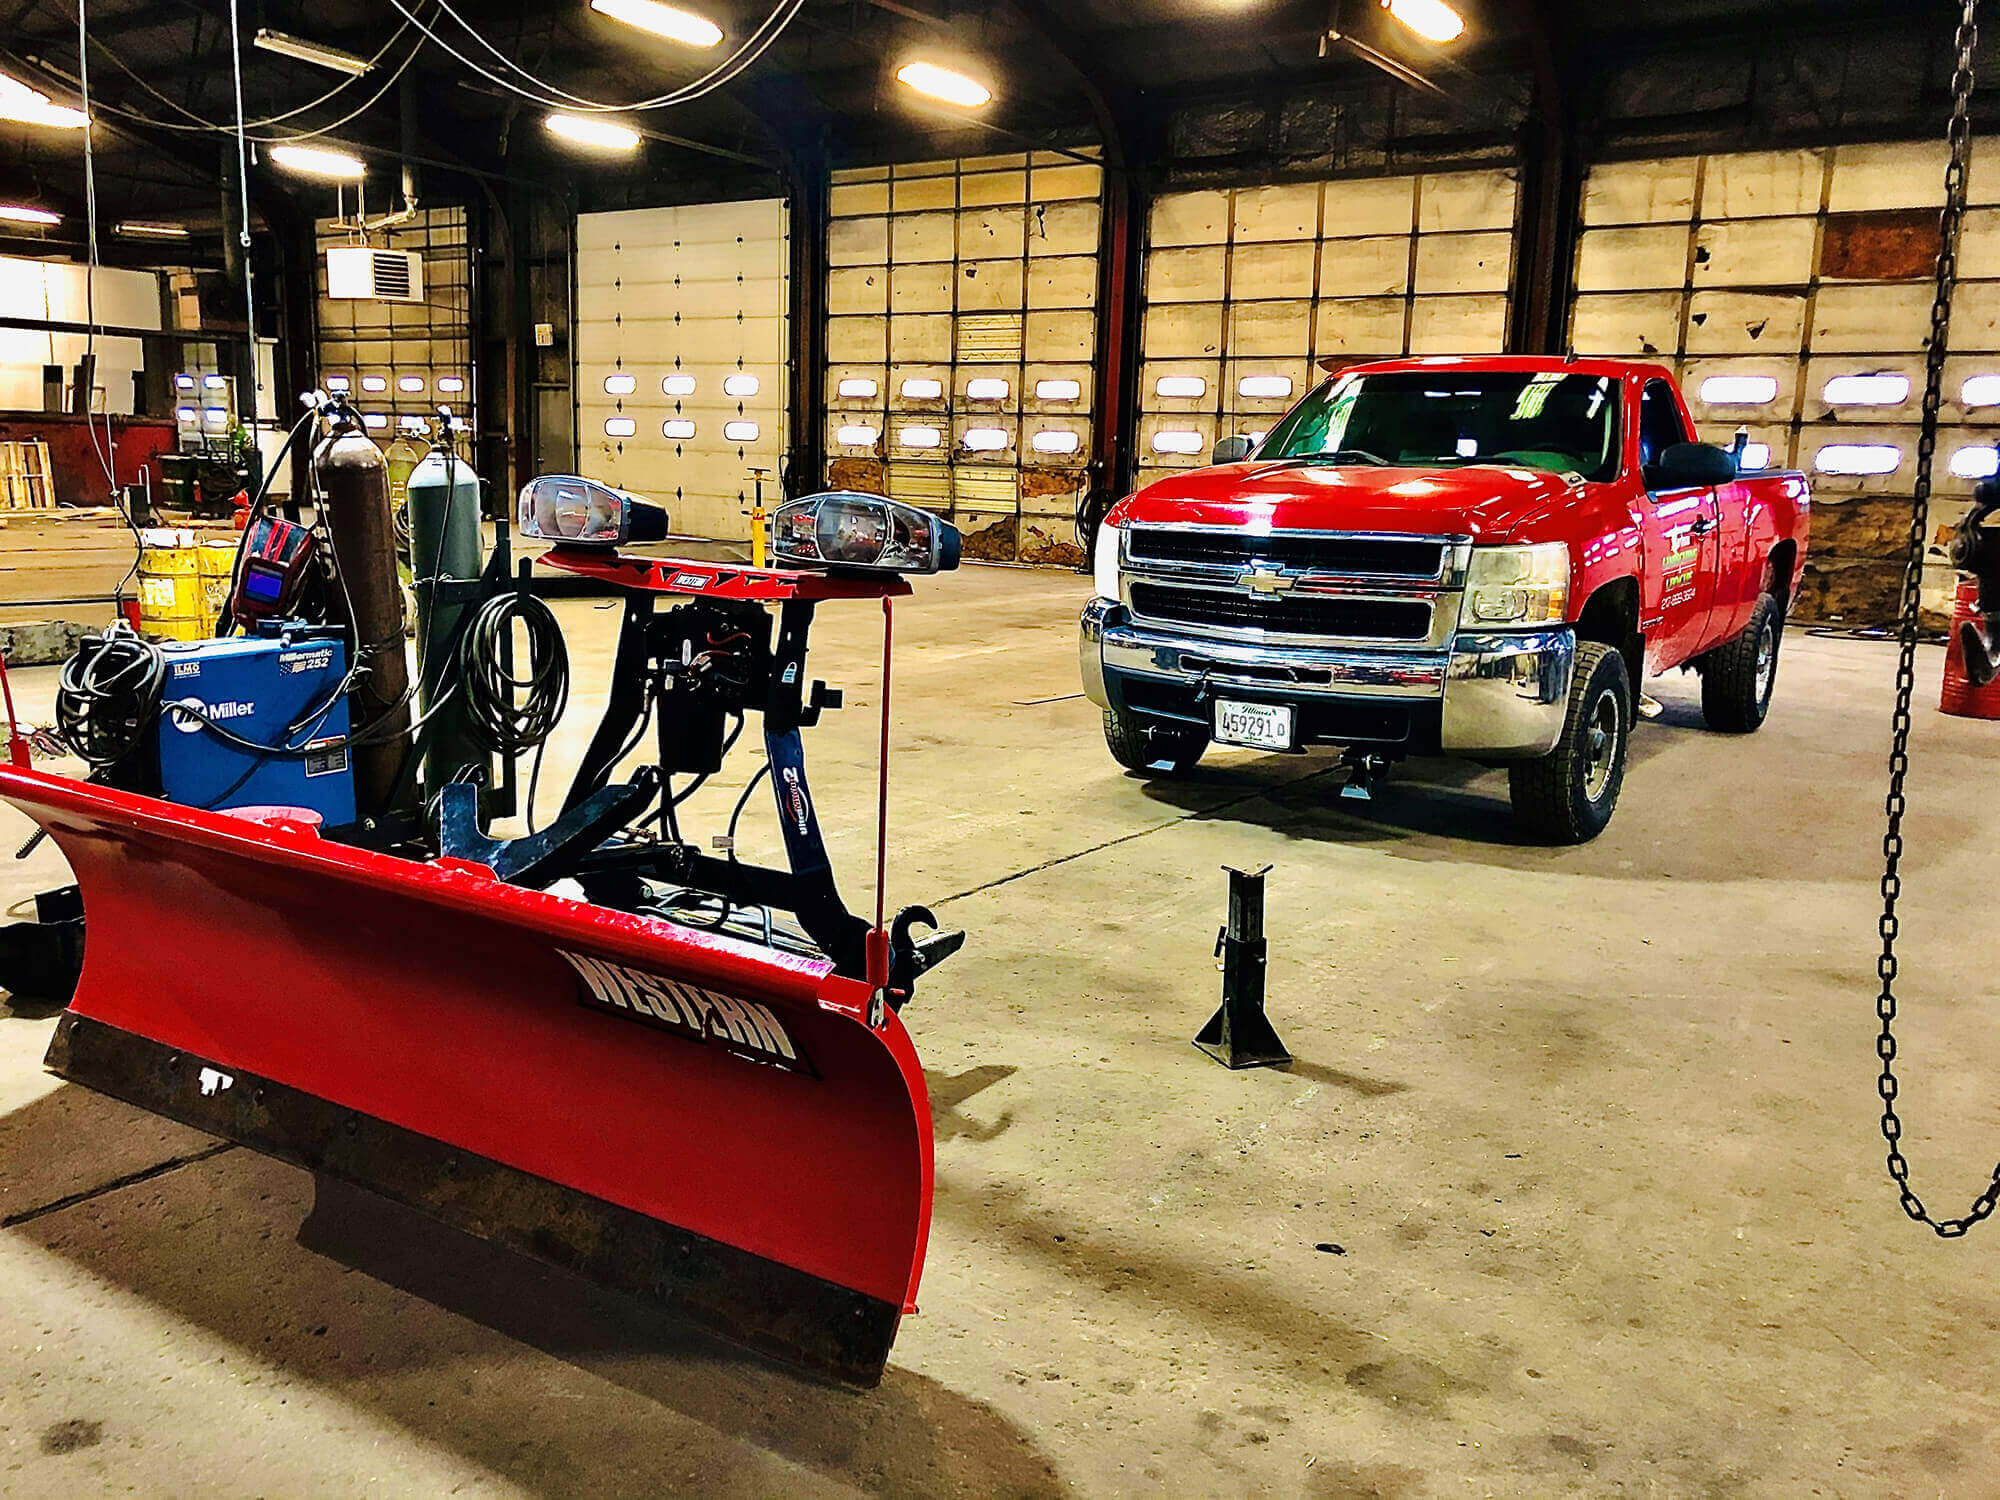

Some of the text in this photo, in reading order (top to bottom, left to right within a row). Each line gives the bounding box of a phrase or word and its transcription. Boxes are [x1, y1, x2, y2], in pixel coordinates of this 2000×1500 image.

[279, 649, 333, 664] Millermatic
[306, 657, 329, 669] 252
[209, 702, 254, 720] Miller
[1223, 711, 1273, 738] 459291
[783, 767, 799, 783] 2
[554, 948, 796, 1060] WESTERN
